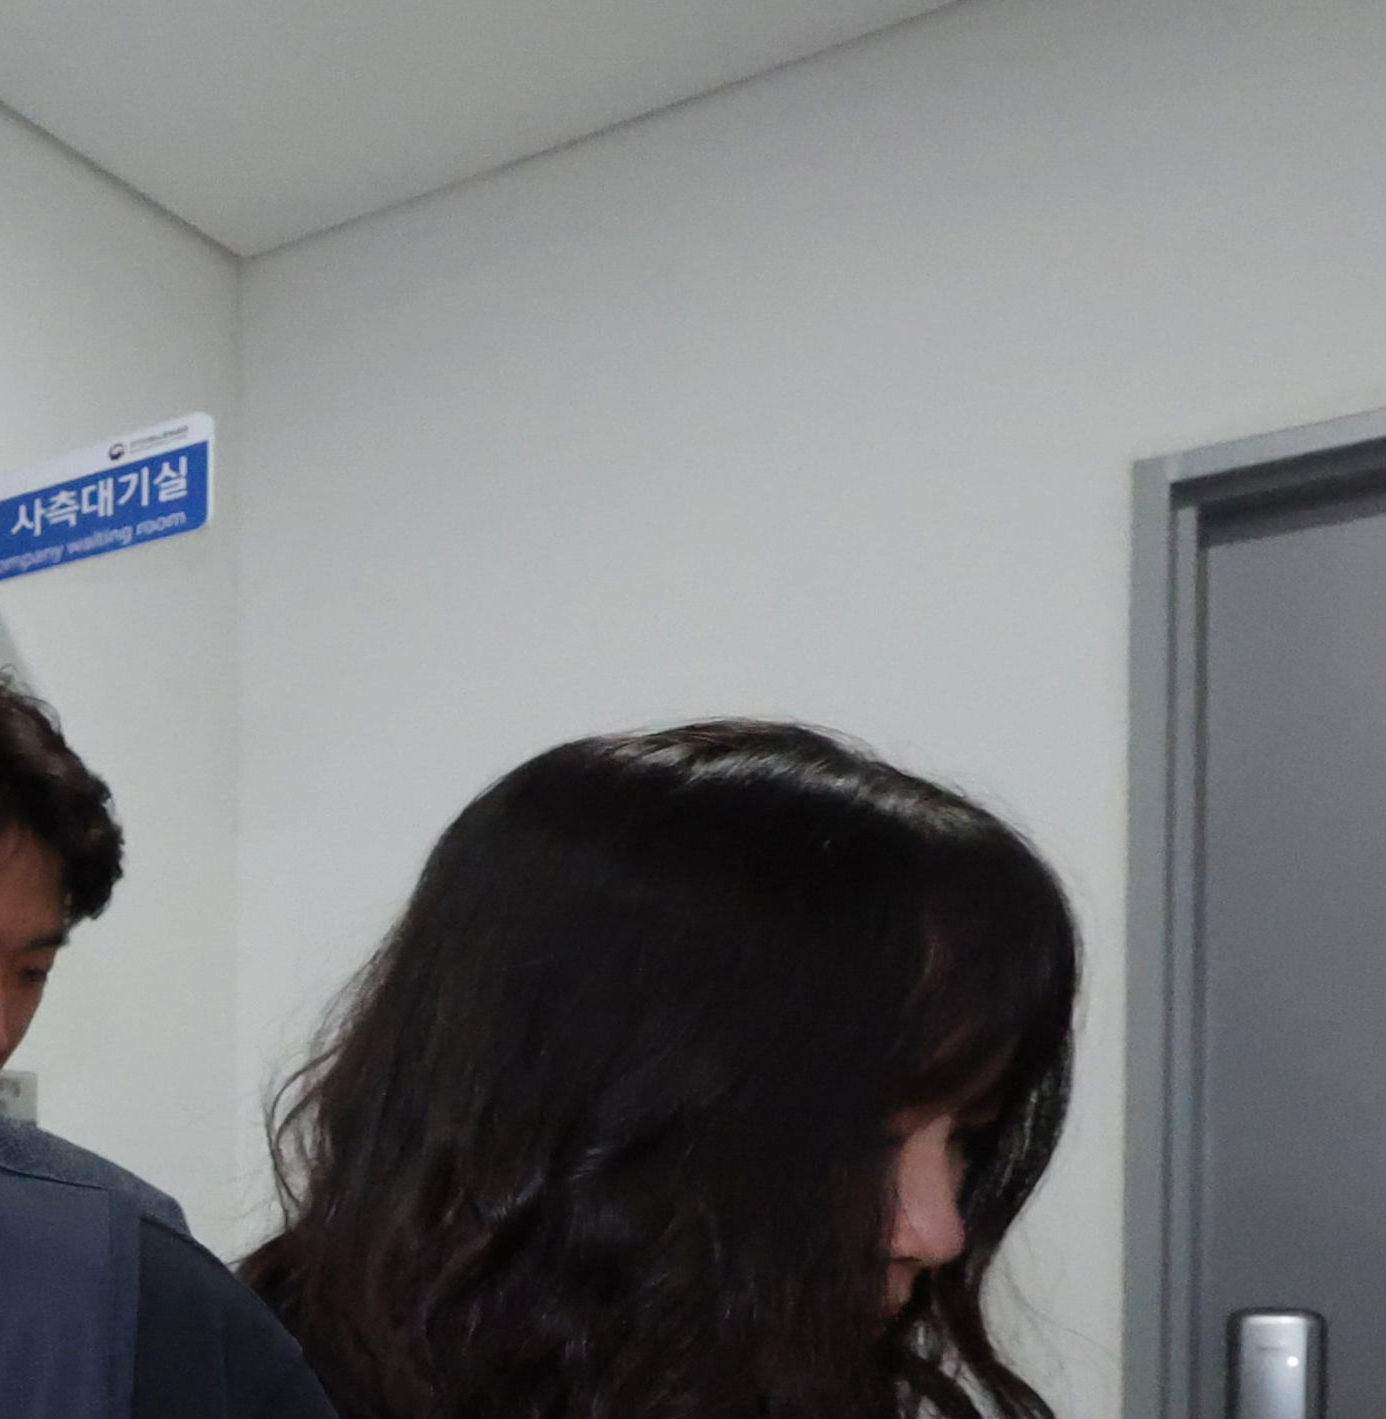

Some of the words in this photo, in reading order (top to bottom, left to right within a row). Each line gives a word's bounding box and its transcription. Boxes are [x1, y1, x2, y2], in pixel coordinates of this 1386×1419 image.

[10, 455, 189, 537] 사측대기실
[67, 523, 133, 555] waiting
[135, 510, 187, 537] room
